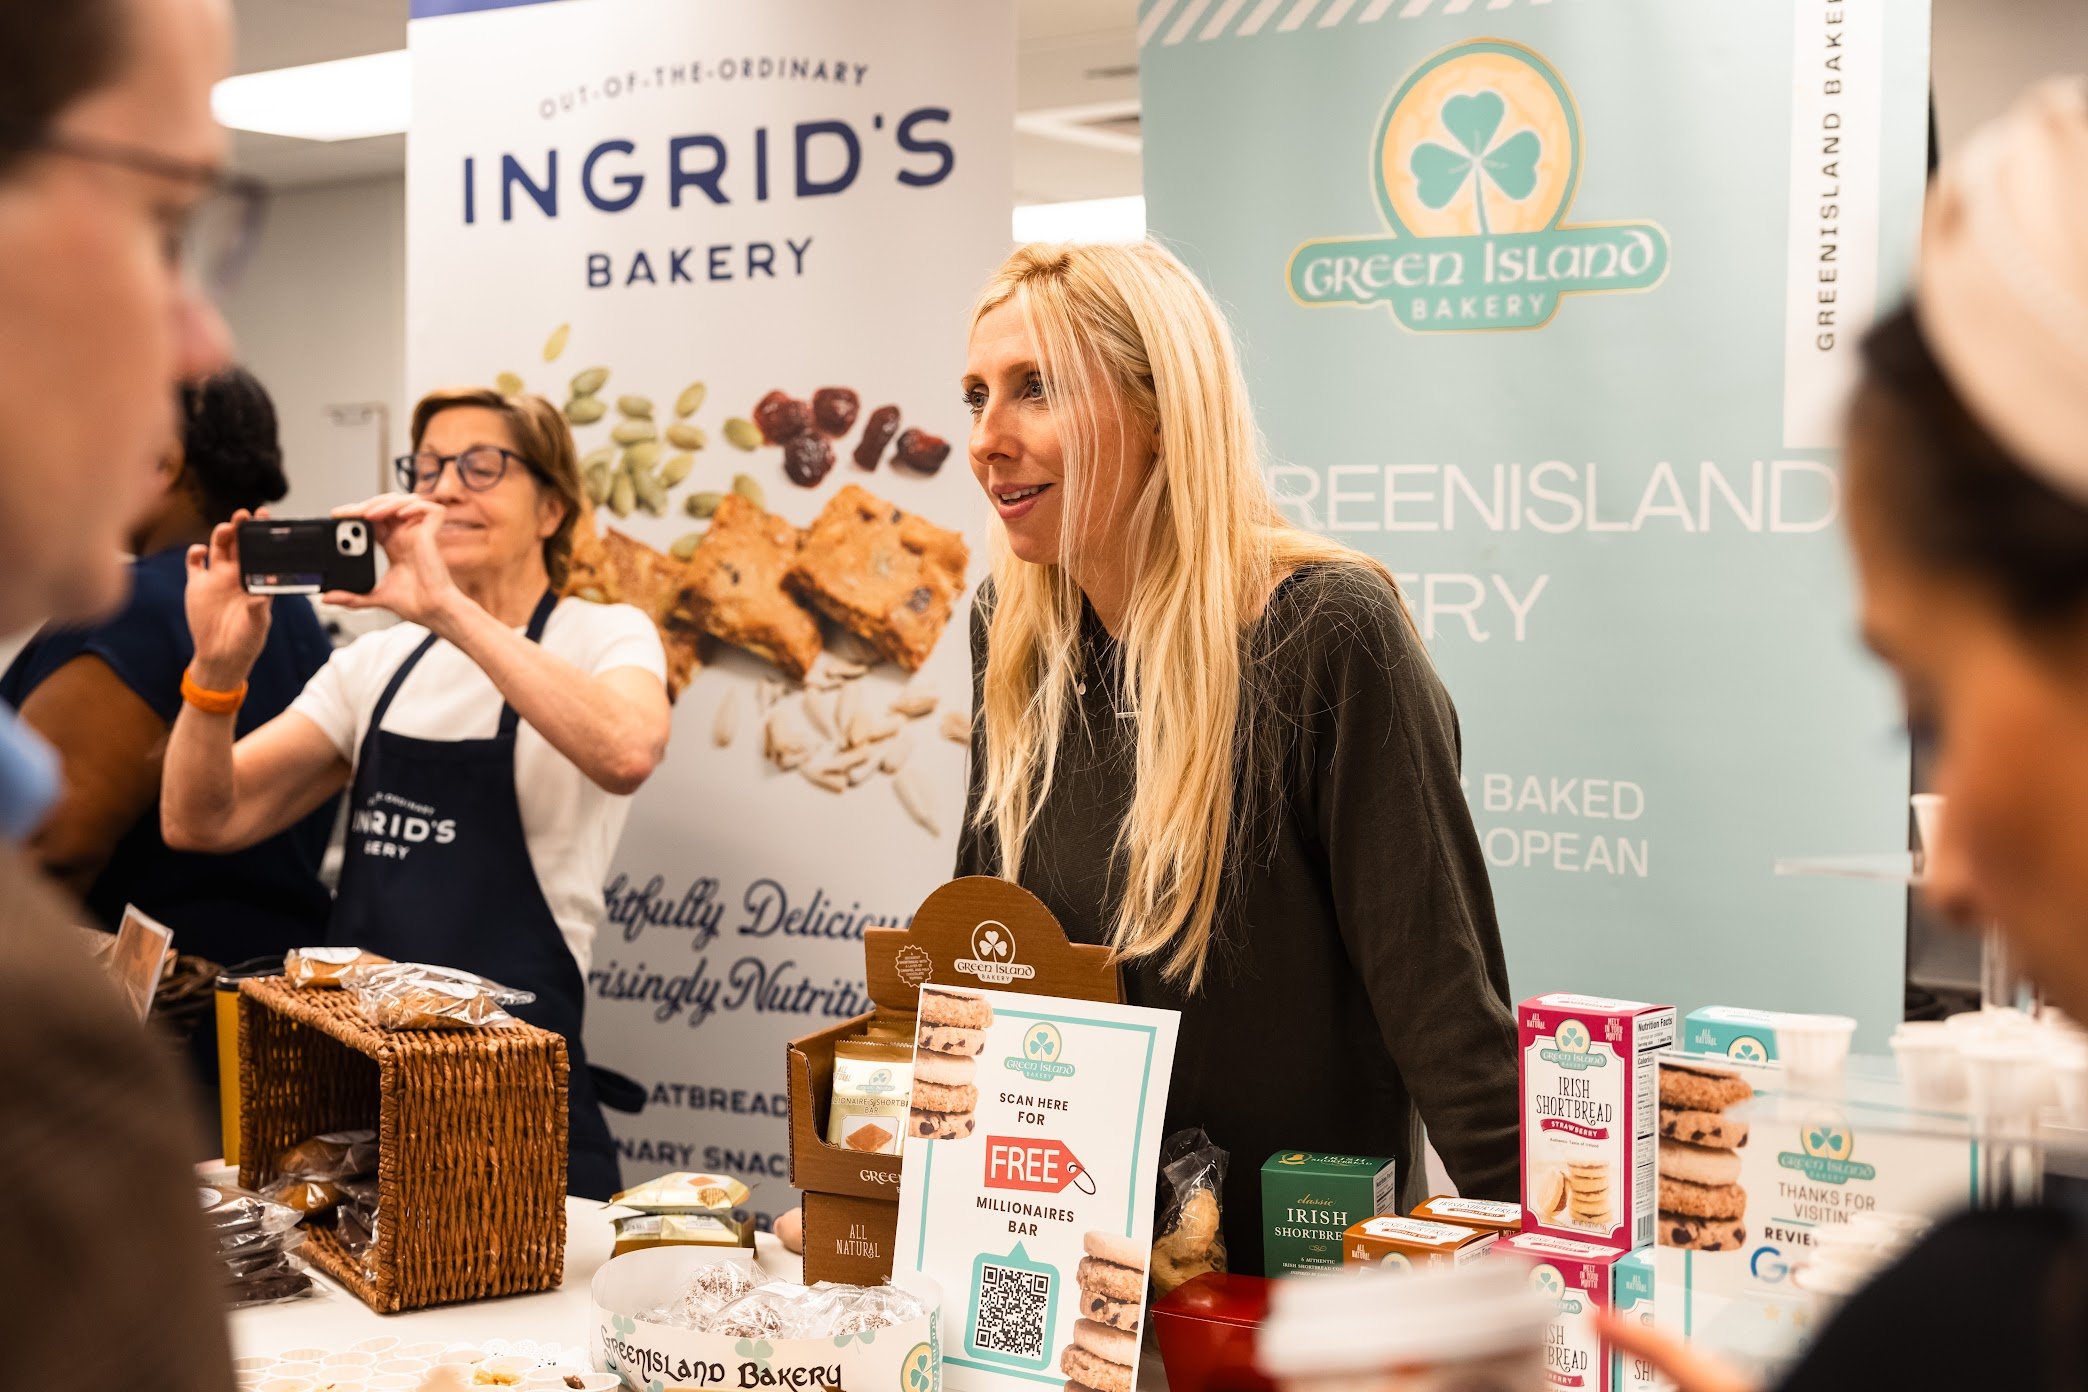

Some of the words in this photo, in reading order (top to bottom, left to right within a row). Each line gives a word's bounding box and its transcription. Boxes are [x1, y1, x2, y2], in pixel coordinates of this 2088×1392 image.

[1823, 0, 1847, 96] BAKE
[539, 57, 869, 120] OUT-OF-THE-ORDINARY
[464, 106, 955, 225] INGRID'S
[1816, 112, 1842, 352] GREENISLAND
[586, 237, 813, 289] BAKERY
[1411, 293, 1547, 320] BAKERY
[1266, 460, 1840, 534] REENISLAND
[1483, 773, 1645, 821] BAKED
[1480, 826, 1649, 878] OPEAN
[602, 873, 724, 952] htfully
[588, 957, 722, 1029] risingly
[722, 957, 874, 1018] Nutriti
[1532, 1013, 1540, 1021] ALL
[1660, 1018, 1673, 1027] Facts
[650, 1081, 788, 1118] ATBREAD
[1558, 1076, 1590, 1099] IRISH
[999, 1093, 1034, 1107] SCAN
[1037, 1097, 1069, 1111] HERE
[1536, 1094, 1612, 1126] SHORTBREAD
[1017, 1111, 1046, 1126] FOR
[1551, 1120, 1598, 1137] STRAWBERRY
[613, 1136, 695, 1167] NARY
[702, 1146, 787, 1178] SNAC
[991, 1145, 1060, 1184] FREE
[976, 1196, 1075, 1222] MILLIONAIRES
[1297, 1193, 1335, 1207] classic
[1778, 1182, 1840, 1206] THANKS
[1845, 1192, 1876, 1211] FOR
[1286, 1208, 1349, 1226] IRISH
[1794, 1203, 1853, 1225] VISITIN
[850, 1224, 867, 1240] ALL
[1008, 1220, 1038, 1237] BAR
[1274, 1227, 1343, 1241] SHORTBRE
[1764, 1226, 1817, 1247] REVIE
[836, 1239, 880, 1259] NATURAL
